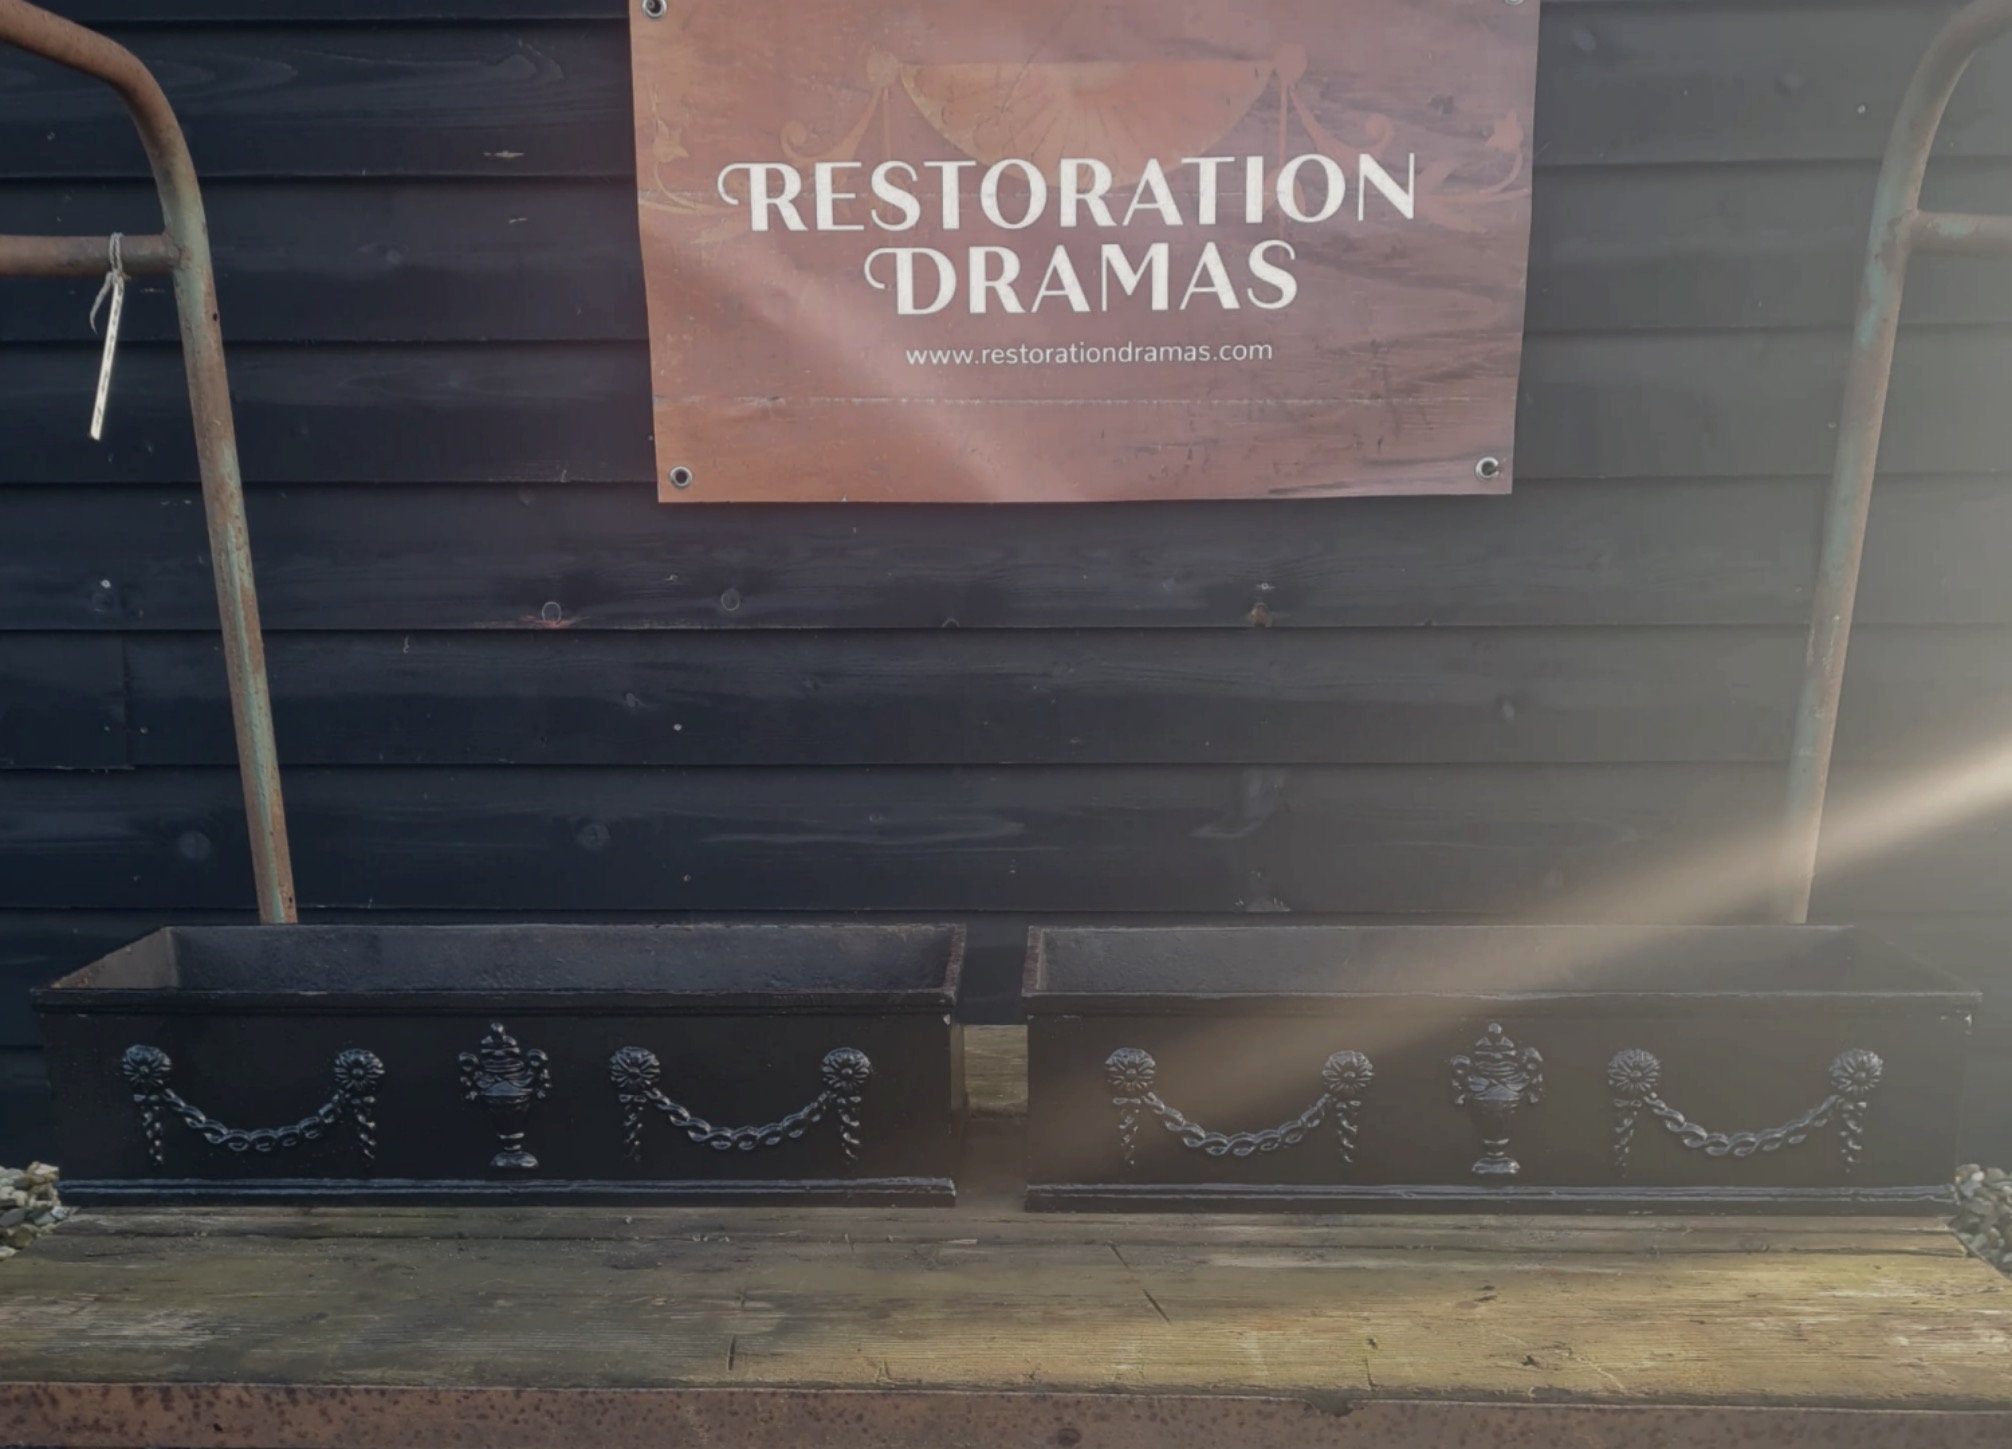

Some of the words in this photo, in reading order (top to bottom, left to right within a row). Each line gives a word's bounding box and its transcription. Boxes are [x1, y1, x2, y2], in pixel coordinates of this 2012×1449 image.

[717, 152, 1417, 232] RESTORATION
[864, 239, 1299, 316] DRAMAS
[906, 340, 1274, 366] www.restorationdramas.com
